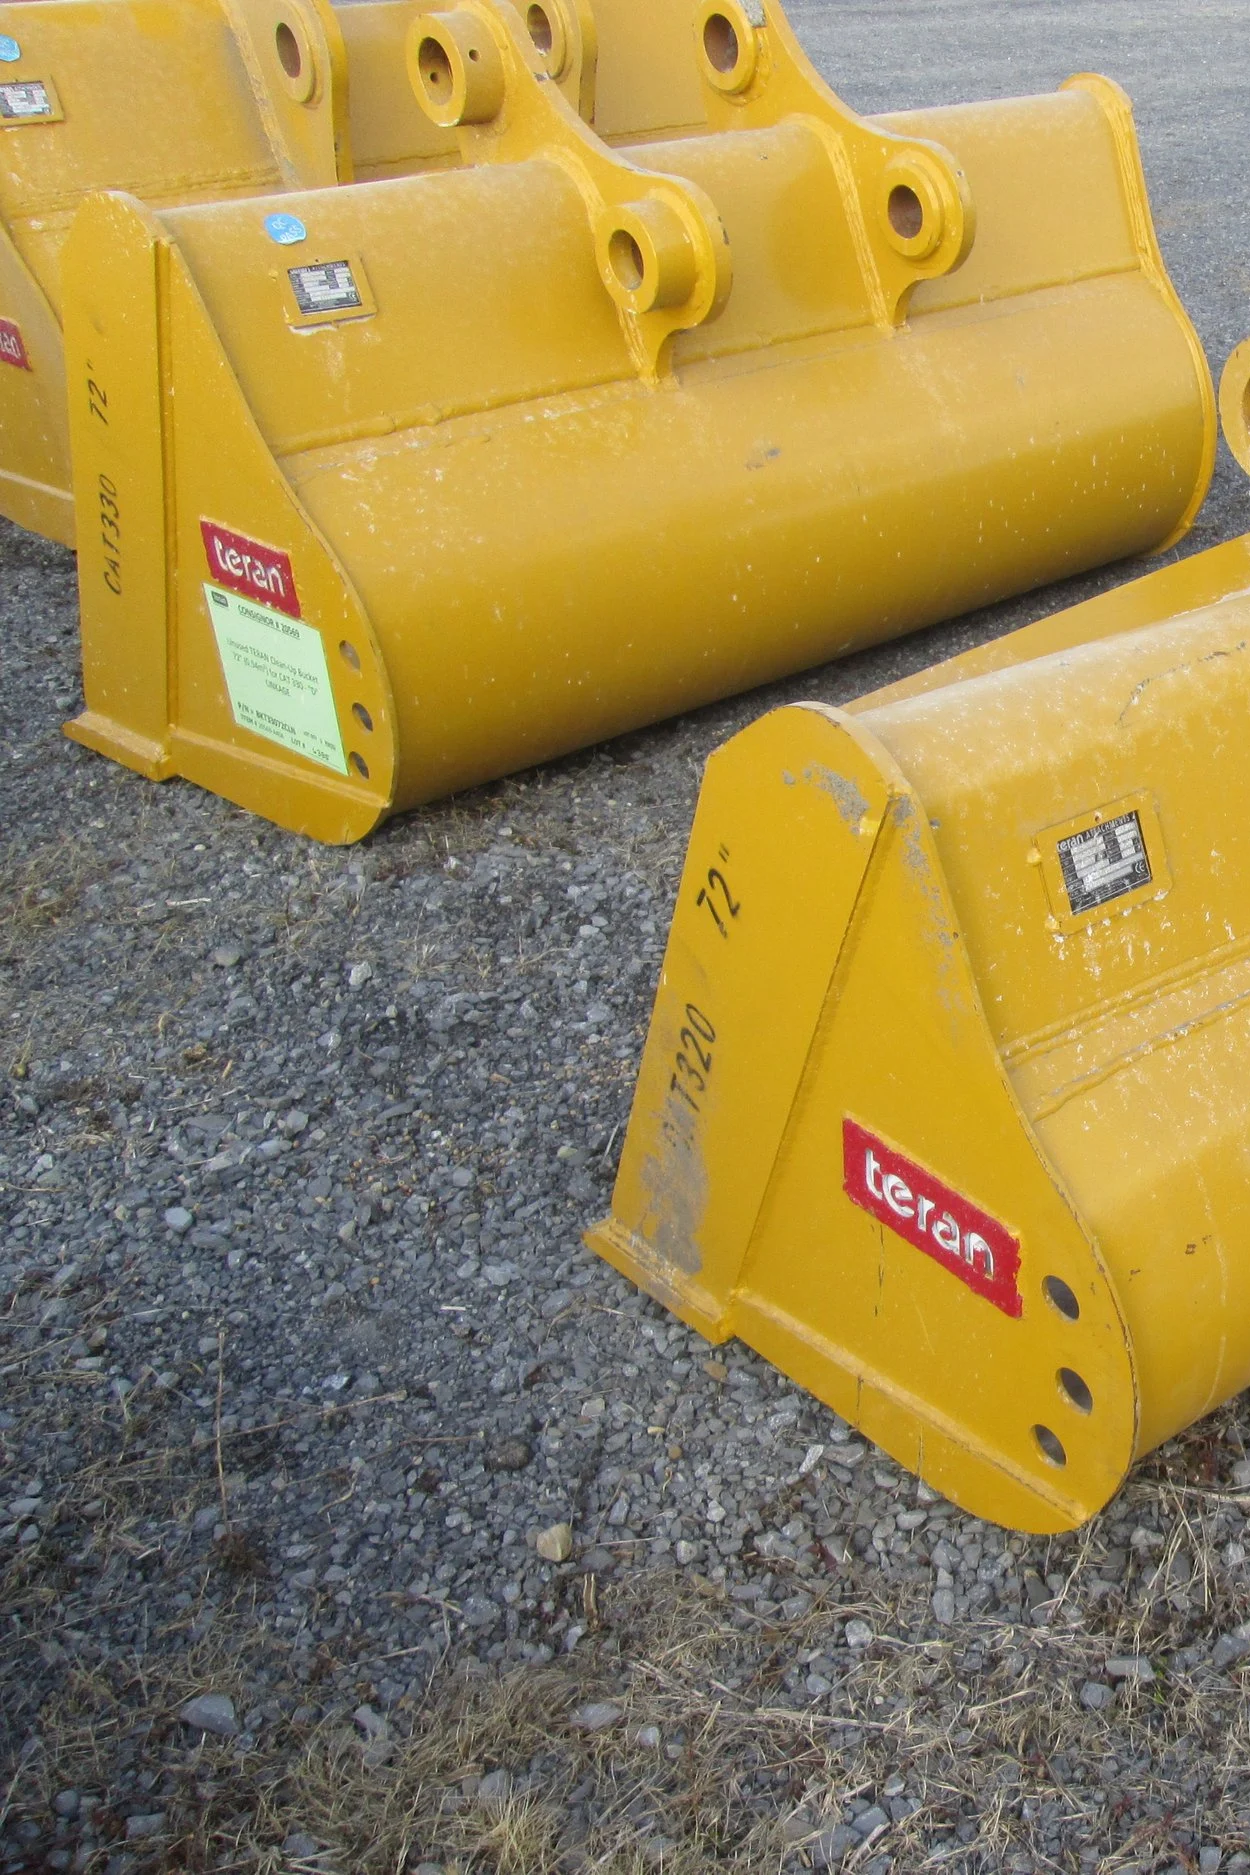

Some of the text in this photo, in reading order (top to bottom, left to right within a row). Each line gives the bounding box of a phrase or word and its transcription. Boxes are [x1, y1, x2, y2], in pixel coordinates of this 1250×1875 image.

[280, 225, 302, 241] PASS
[100, 474, 121, 595] CAT330
[214, 535, 285, 598] teran
[237, 603, 274, 628] CONSIGNOR
[696, 842, 742, 940] 72"
[865, 1148, 995, 1281] teran
